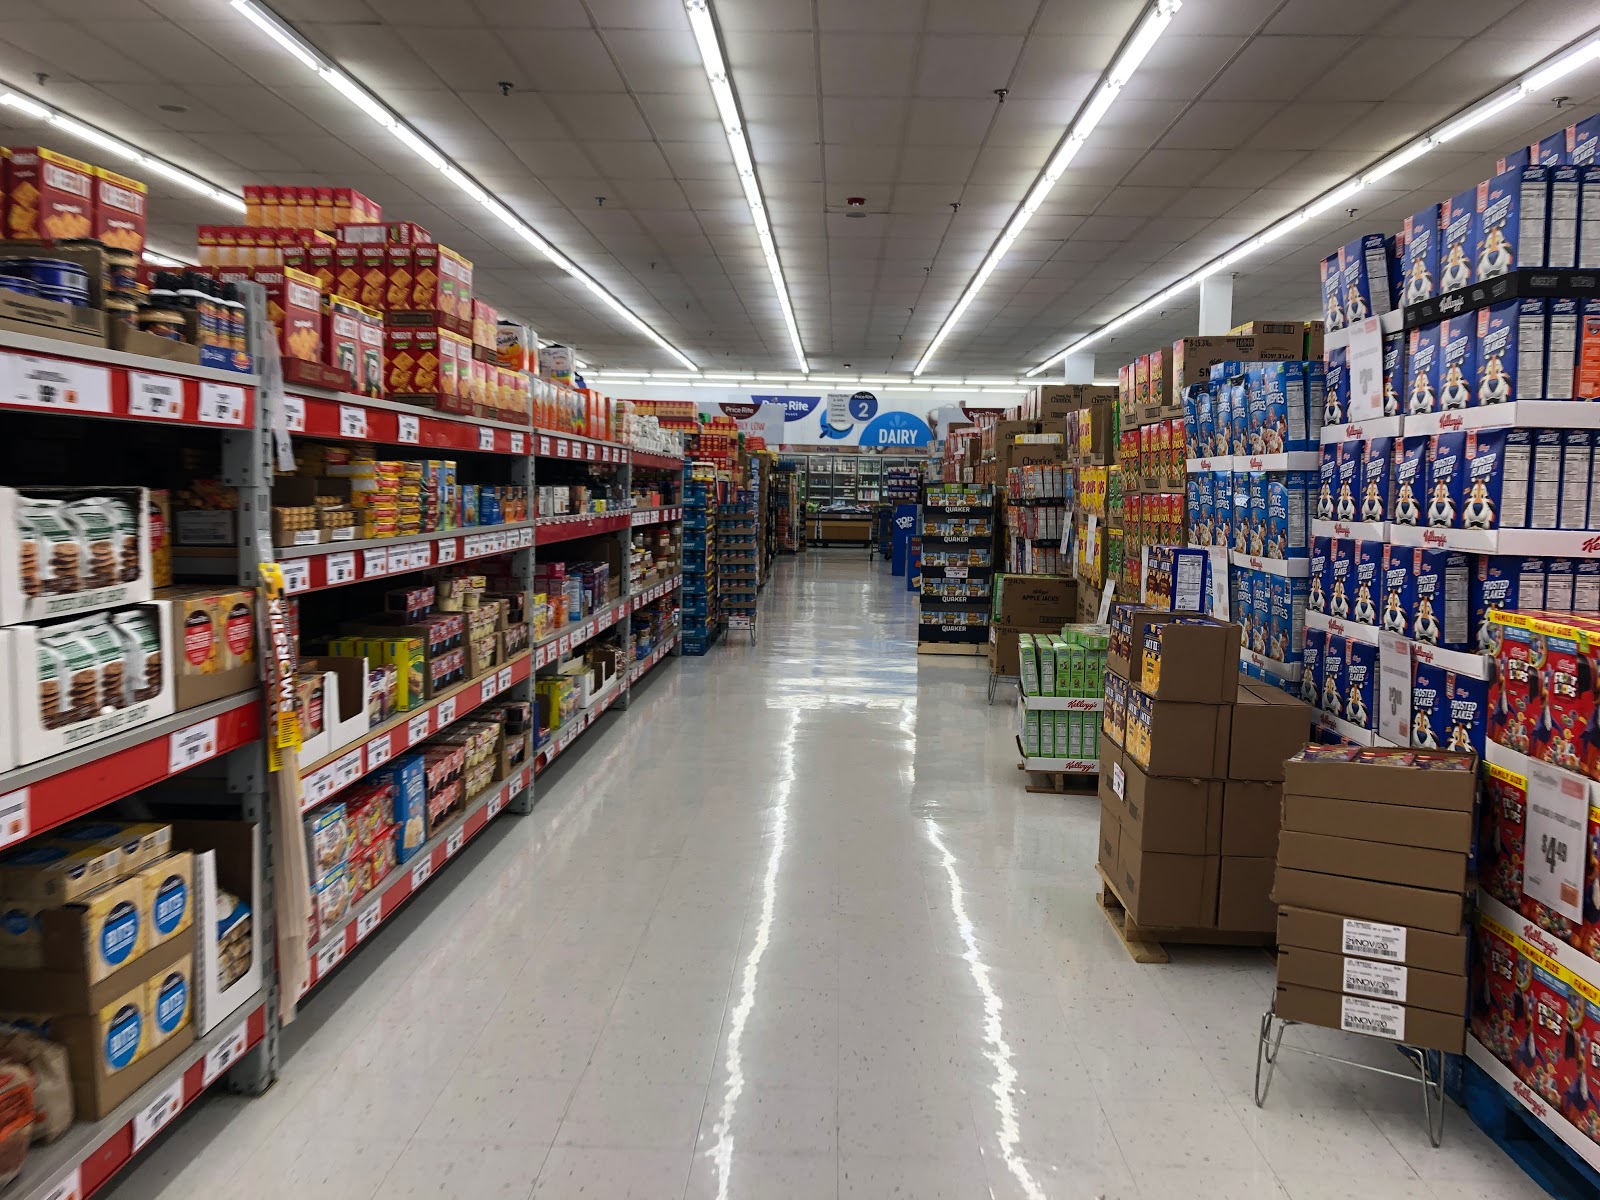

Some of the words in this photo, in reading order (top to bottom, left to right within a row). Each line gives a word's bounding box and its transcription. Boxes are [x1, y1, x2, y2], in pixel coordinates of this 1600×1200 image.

[1439, 292, 1465, 313] Kellogg's
[788, 401, 809, 411] Rite
[858, 402, 869, 417] 2
[1439, 413, 1464, 431] Kellogg's
[879, 429, 918, 444] DAIRY
[1023, 457, 1053, 465] Cheerios
[1470, 453, 1496, 469] FROSTED
[1470, 464, 1492, 478] FLAKES
[1423, 529, 1447, 547] Kellogg's
[1387, 568, 1407, 579] FROSTED
[1387, 577, 1404, 586] FLAKES
[1418, 574, 1438, 585] FROSTED
[1482, 580, 1510, 590] FROSTED
[1418, 583, 1435, 593] FLAKES
[1483, 589, 1507, 599] FLAKES
[1494, 613, 1513, 624] FAMILY
[1513, 616, 1527, 626] SIZE
[1534, 622, 1554, 633] FAMILY
[1557, 626, 1572, 636] SIZE
[1411, 644, 1434, 663] Kellogg's
[1325, 656, 1342, 666] FROSTED
[1325, 663, 1340, 672] FLAKES
[1349, 665, 1367, 675] FROSTED
[1349, 672, 1365, 681] FLAKES
[1413, 688, 1437, 699] FROSTED
[1067, 700, 1098, 710] Kellogg's
[1413, 696, 1434, 707] FLAKES
[1451, 700, 1478, 712] FROSTED
[1452, 709, 1475, 721] FLAKES
[1065, 761, 1096, 771] Kellogg's
[1491, 767, 1509, 780] FAMILY
[1510, 773, 1523, 786] SIZE
[1522, 944, 1543, 964] FAMILY
[1544, 960, 1560, 975] SIZE
